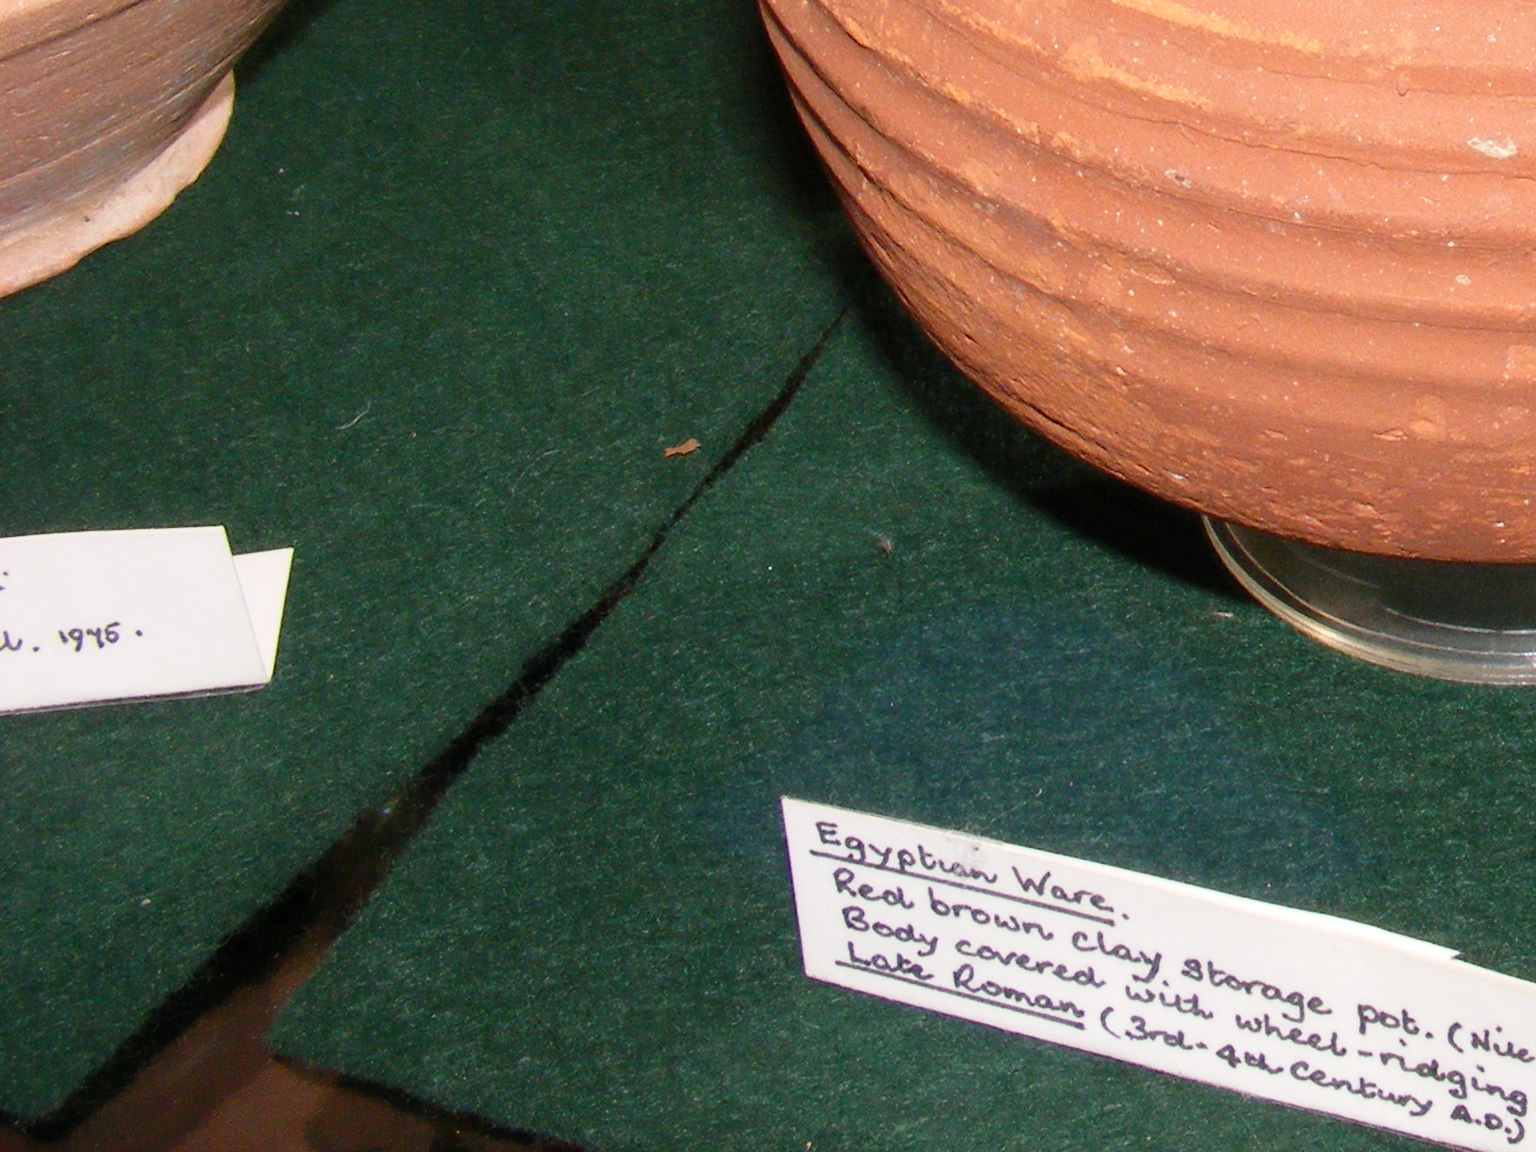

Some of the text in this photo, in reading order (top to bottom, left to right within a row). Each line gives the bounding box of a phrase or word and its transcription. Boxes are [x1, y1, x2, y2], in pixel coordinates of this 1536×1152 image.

[815, 821, 1129, 919] Egyptian Ware.
[832, 867, 914, 909] Red
[928, 886, 1054, 940] brown
[1357, 1004, 1434, 1039] pot.
[1447, 1022, 1536, 1062] (Nile
[841, 905, 938, 956] Body
[954, 940, 1105, 987] covered
[1125, 981, 1214, 1019] with
[847, 941, 935, 981] Late
[952, 963, 1085, 1018] Roman
[1450, 1104, 1525, 1145] A.D.)
